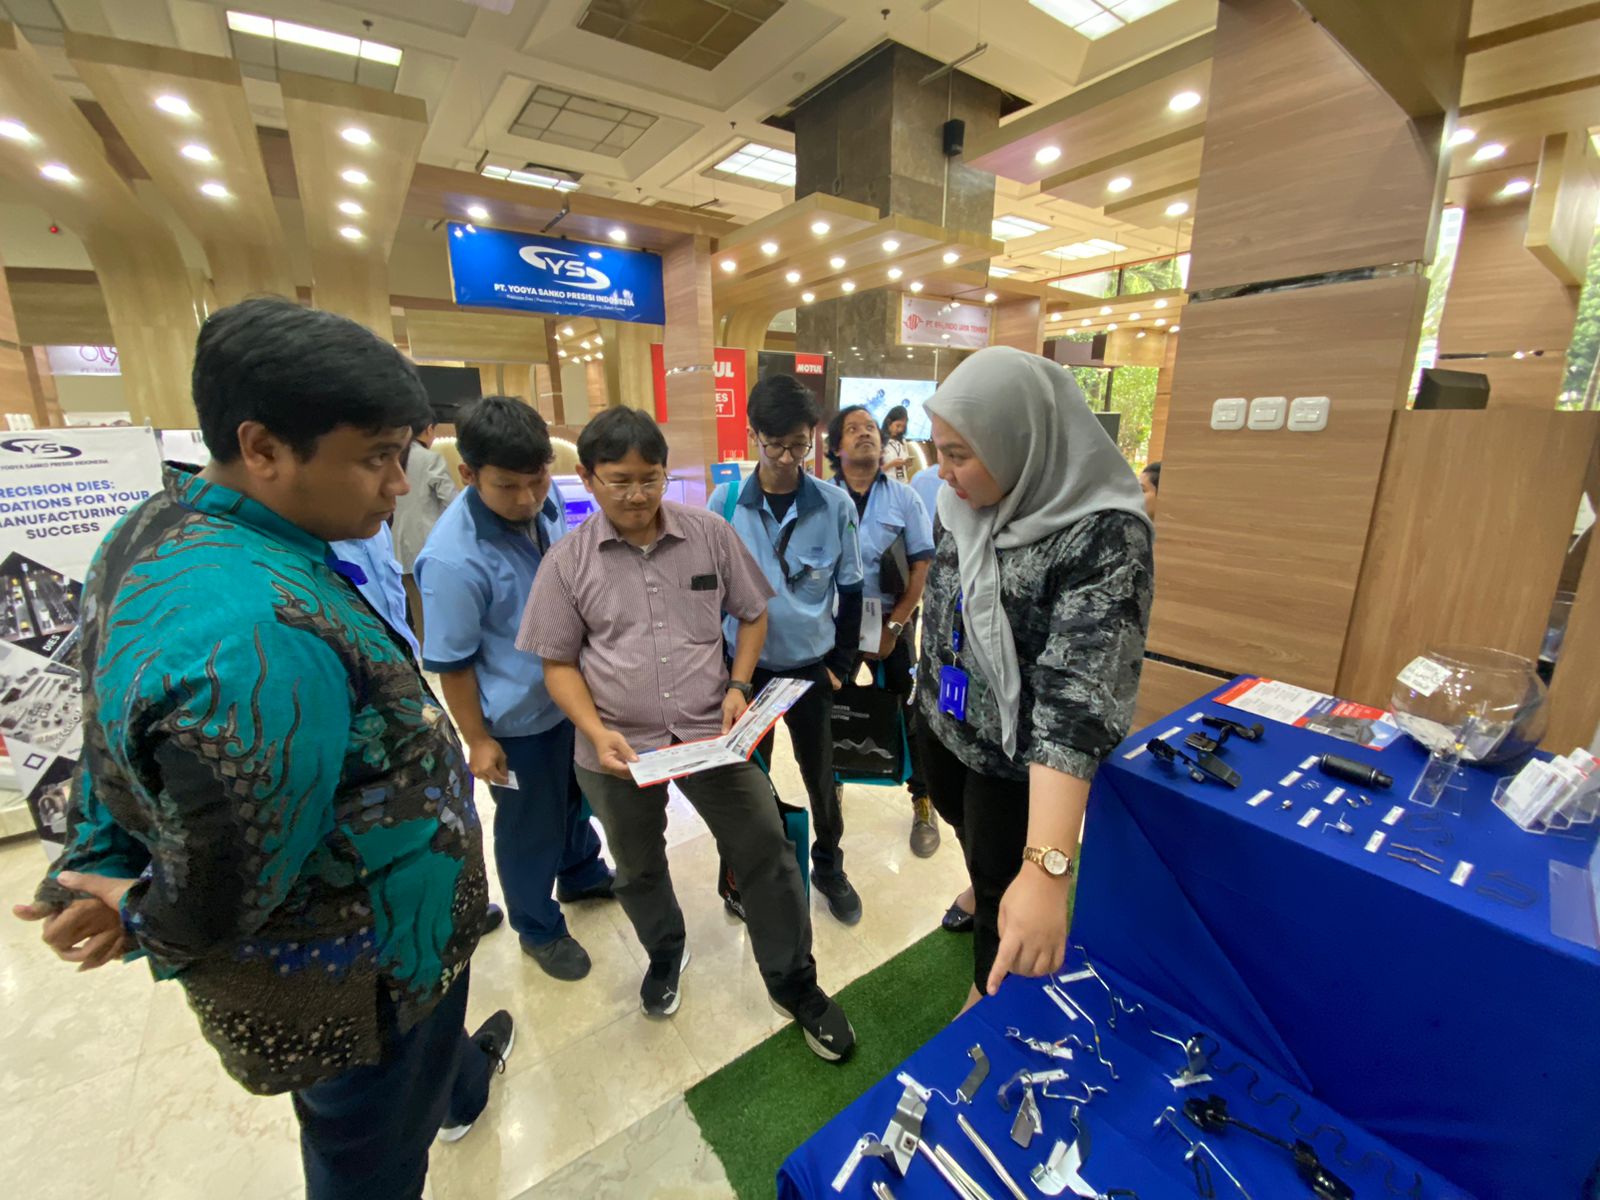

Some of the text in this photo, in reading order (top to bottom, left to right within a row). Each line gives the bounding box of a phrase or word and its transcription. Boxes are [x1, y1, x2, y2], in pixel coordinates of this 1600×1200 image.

[493, 283, 635, 307] PT. YOGYA SANKO PRESISI INDONESIA
[797, 364, 823, 374] MOTUL
[76, 479, 115, 493] DIES:
[75, 494, 106, 505] FOR
[109, 490, 150, 502] YOUR
[26, 522, 100, 540] SUCCESS
[42, 634, 60, 651] DIES
